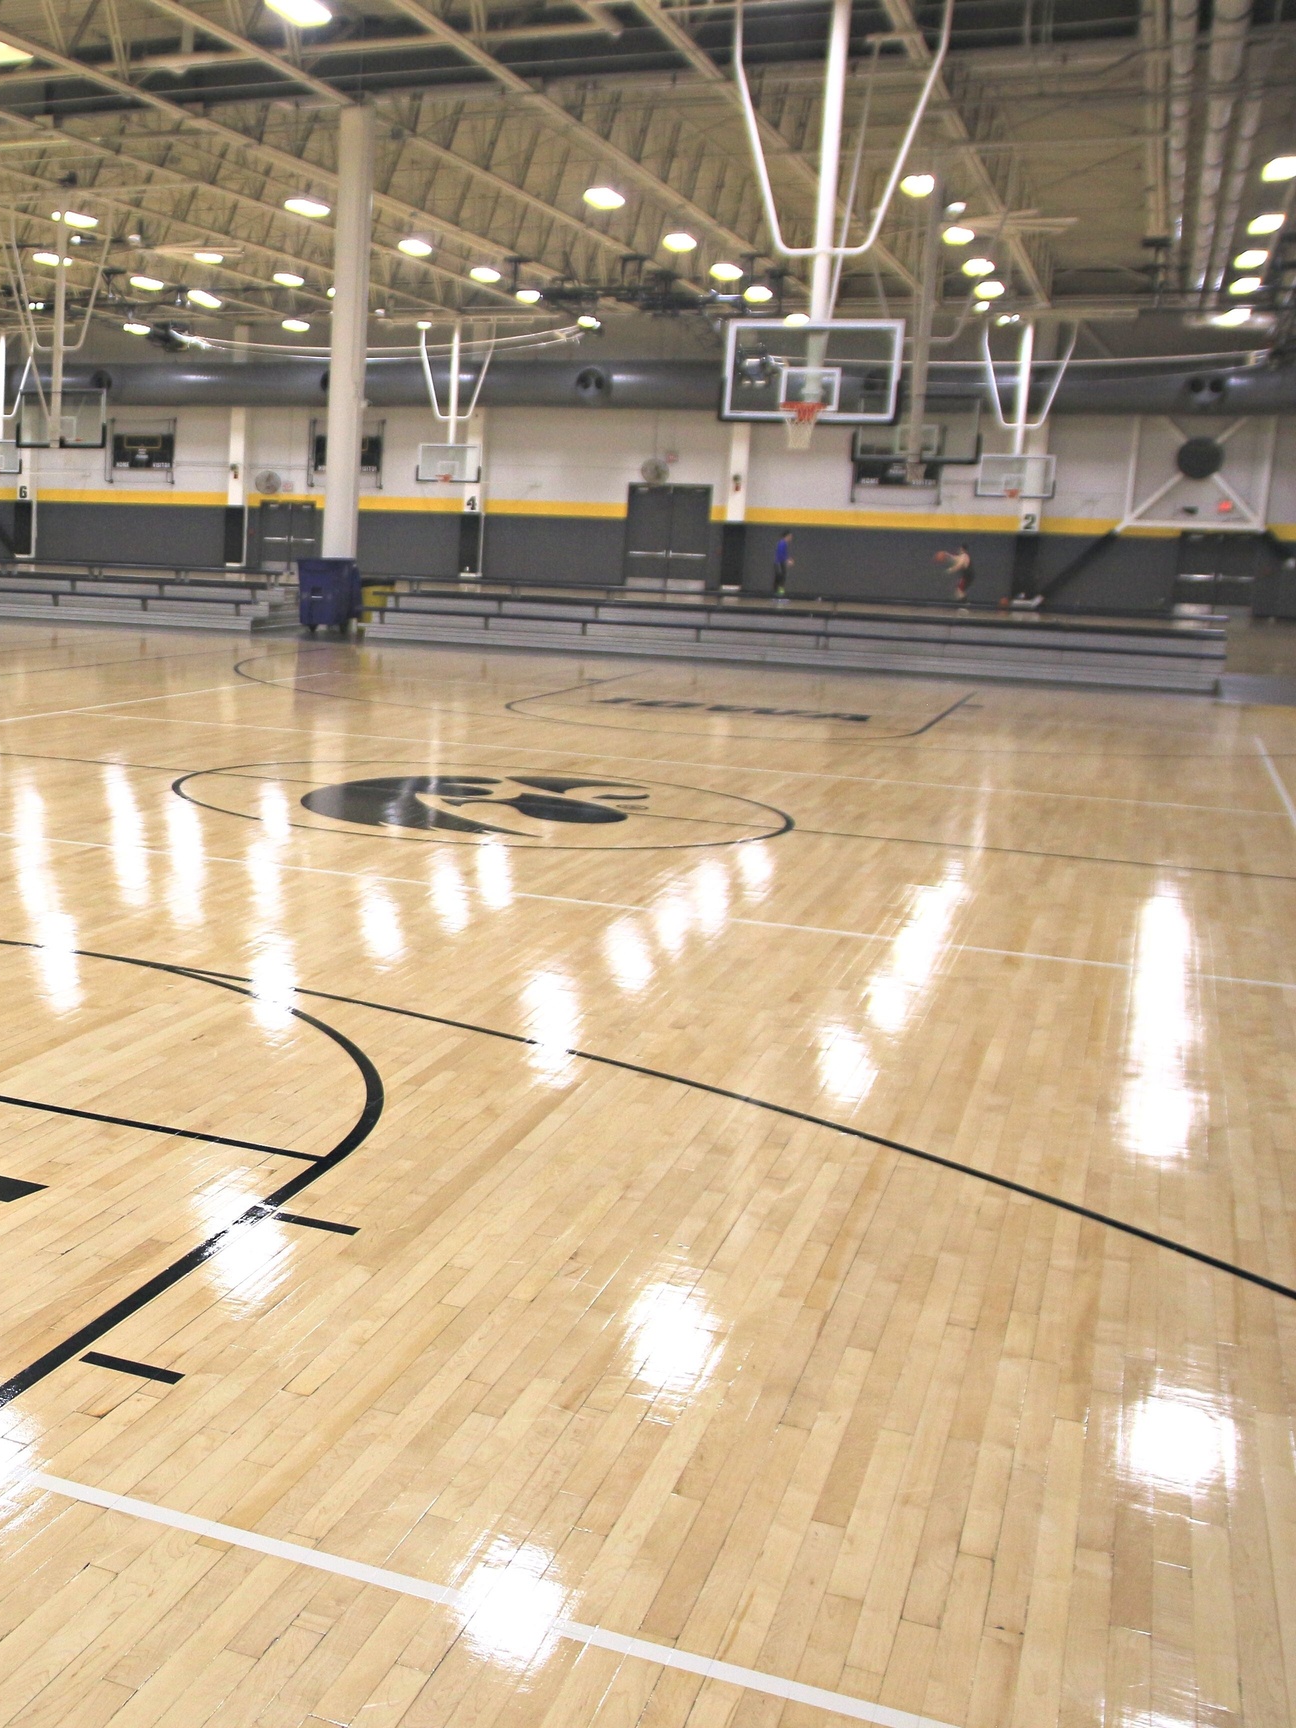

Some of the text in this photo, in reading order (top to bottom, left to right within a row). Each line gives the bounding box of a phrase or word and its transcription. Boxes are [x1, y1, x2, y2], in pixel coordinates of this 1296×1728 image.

[19, 485, 28, 499] 6
[466, 495, 477, 511] 4
[1023, 513, 1037, 530] 2
